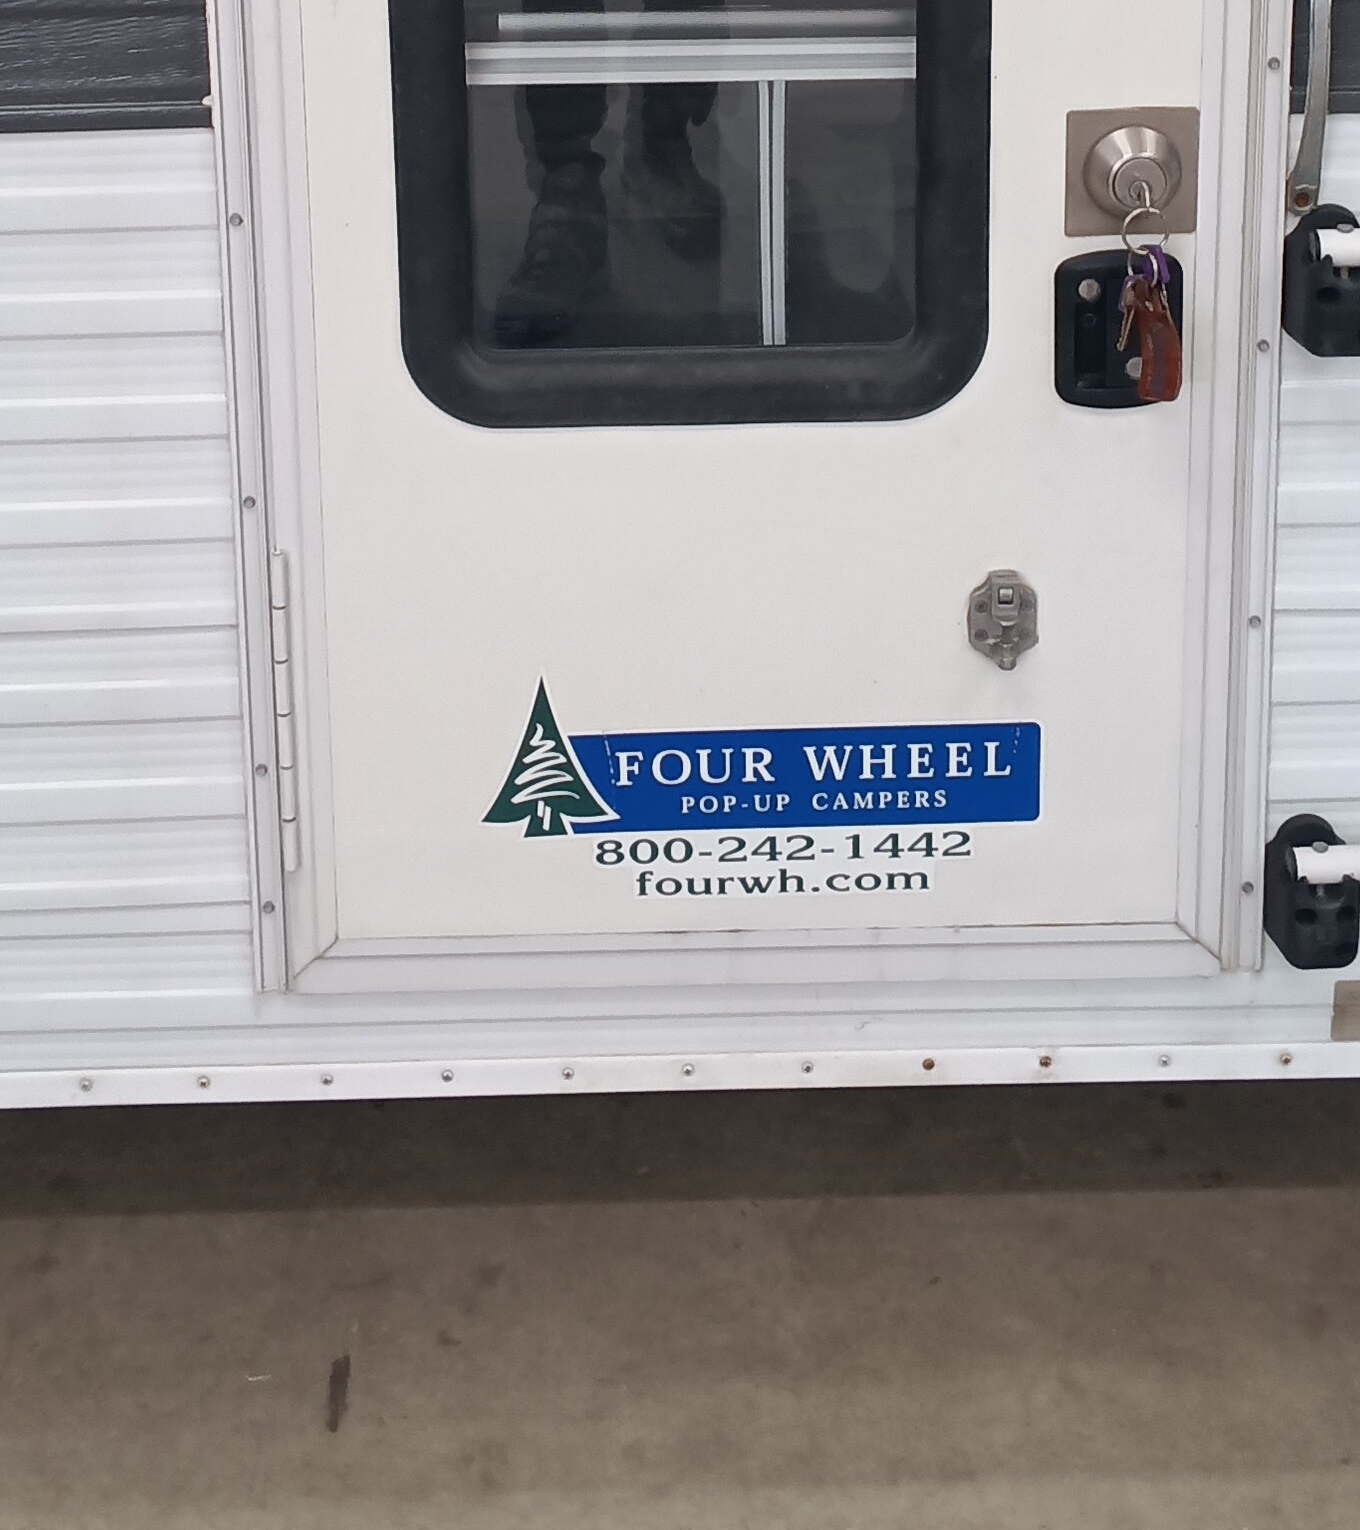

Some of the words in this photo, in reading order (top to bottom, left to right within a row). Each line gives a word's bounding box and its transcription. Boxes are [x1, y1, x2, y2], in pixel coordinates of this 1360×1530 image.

[615, 747, 776, 787] FOUR
[803, 741, 1012, 782] WHEEL
[681, 794, 791, 814] POP-UP
[812, 789, 947, 811] CAMPERS
[595, 830, 972, 865] 800-242-1442
[636, 868, 930, 896] fourwh.com
